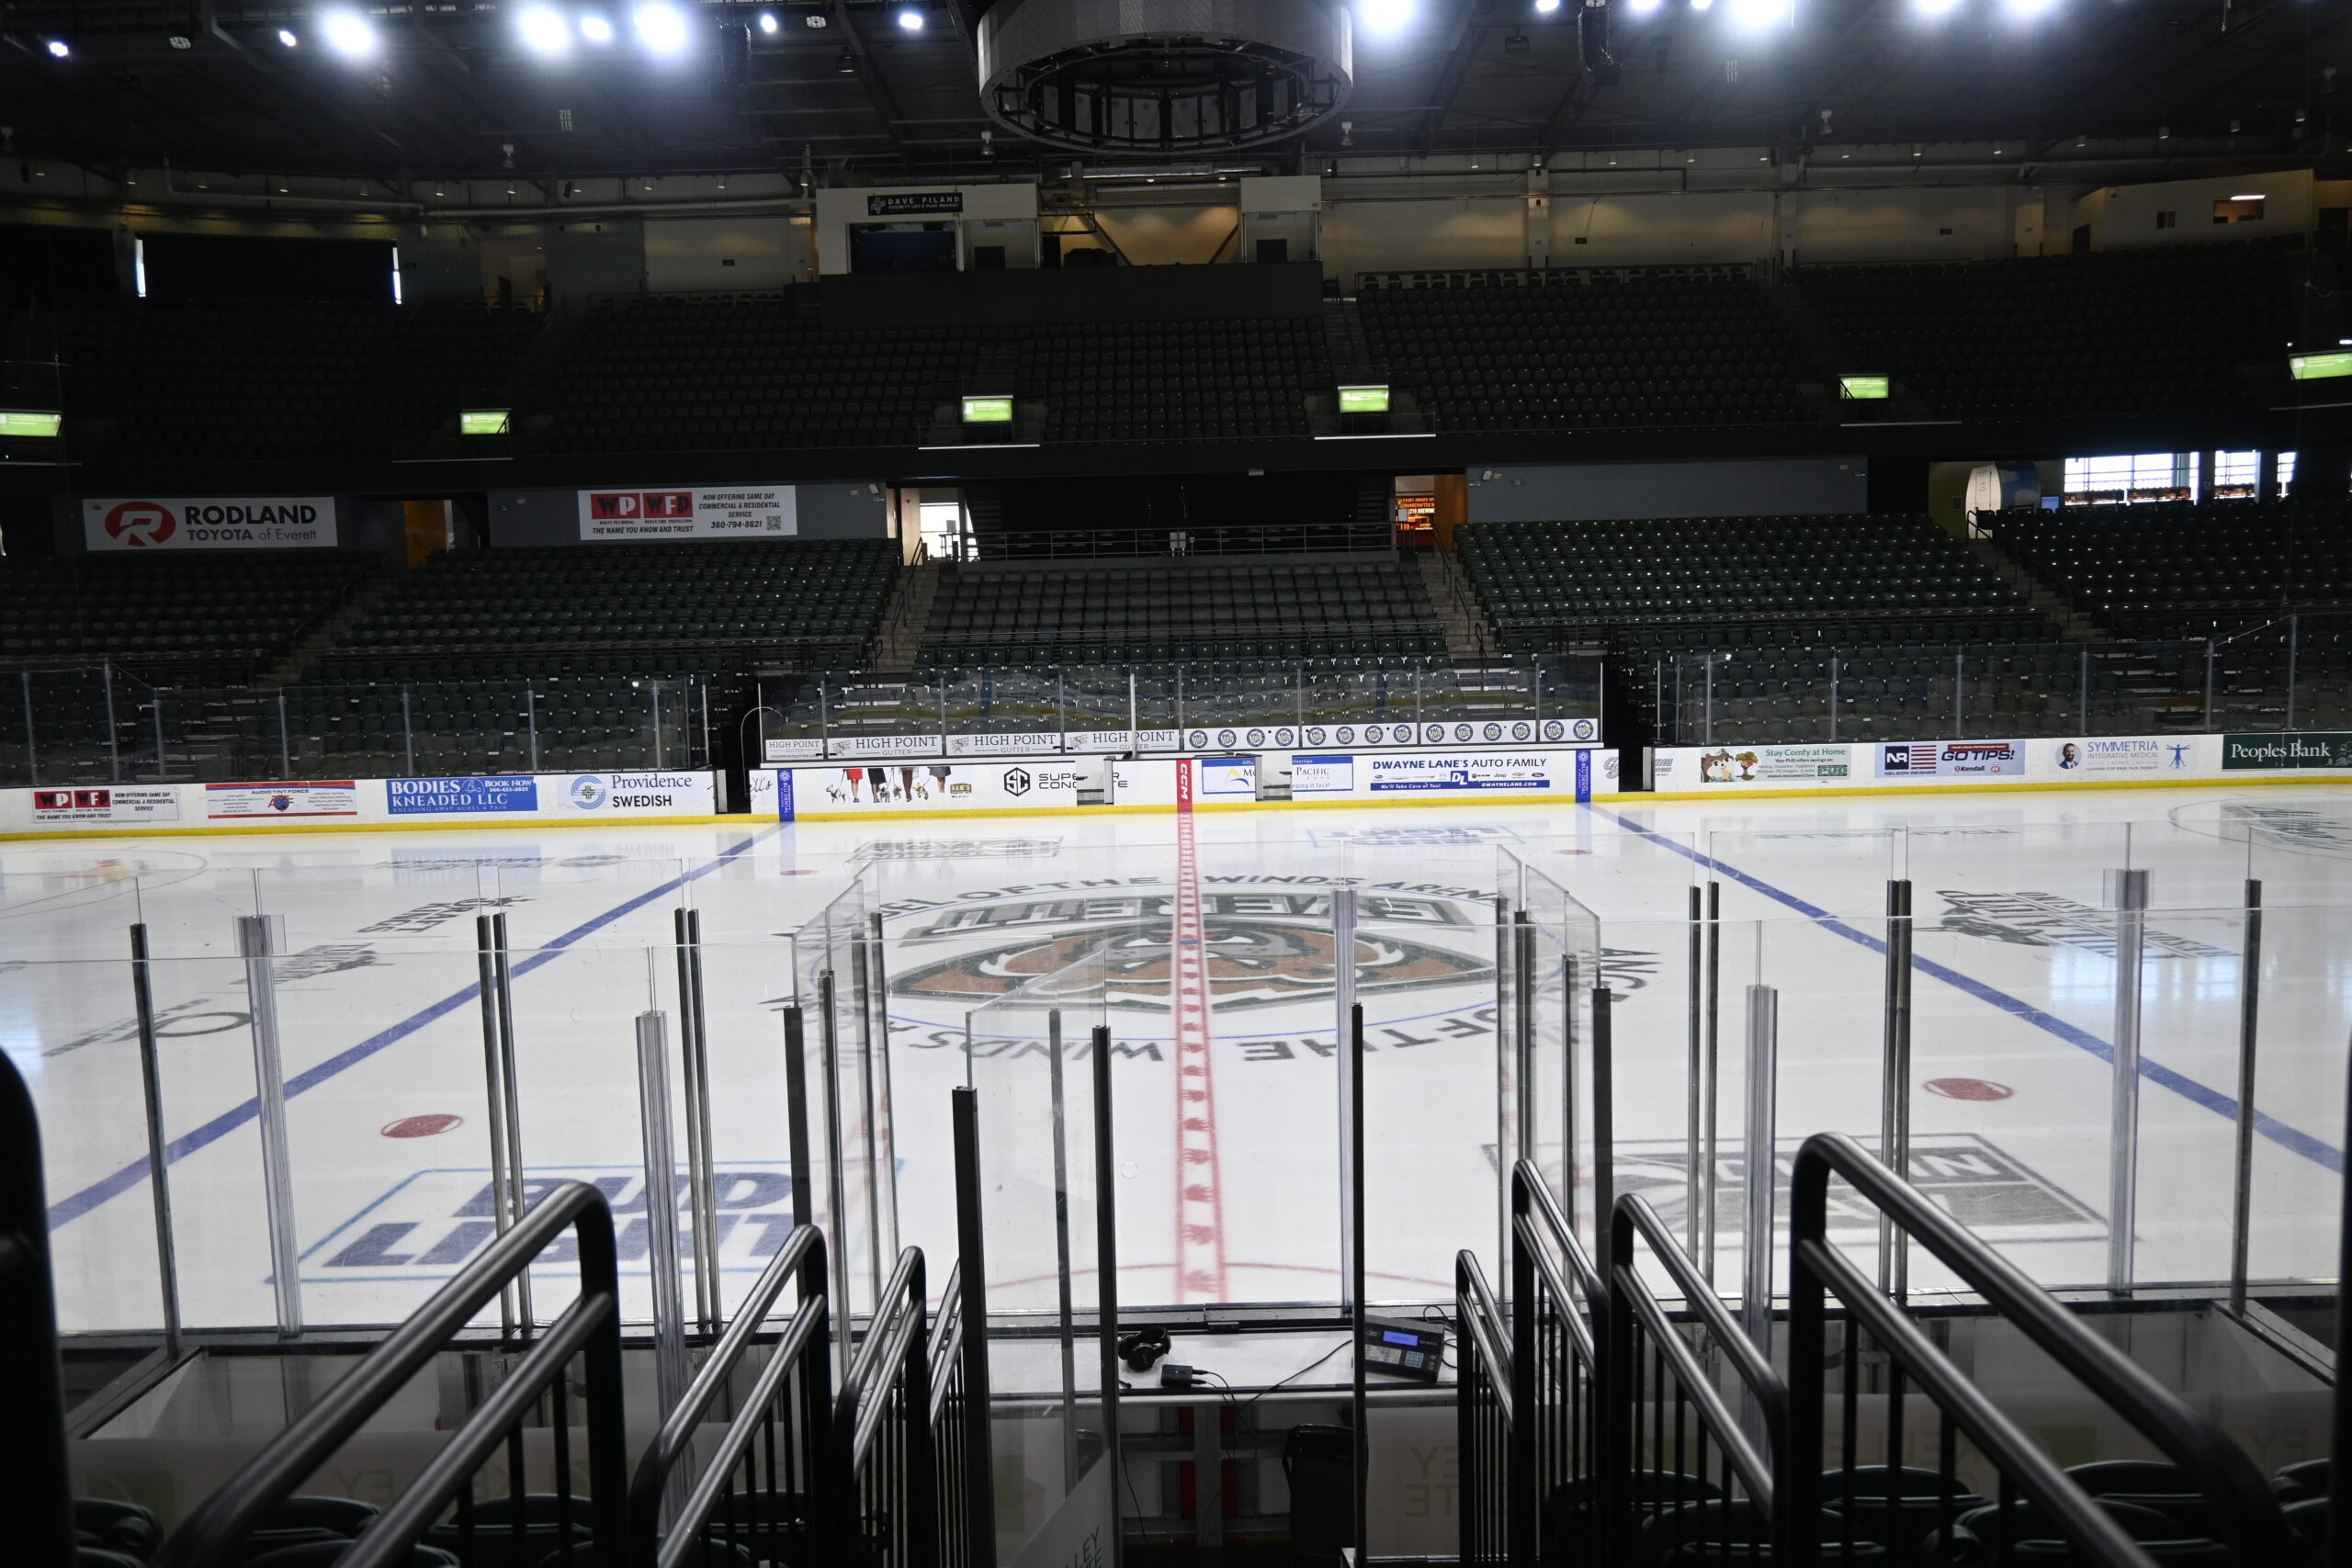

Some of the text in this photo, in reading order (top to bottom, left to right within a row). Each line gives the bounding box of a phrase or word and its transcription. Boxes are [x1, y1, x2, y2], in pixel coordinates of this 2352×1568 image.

[922, 196, 960, 204] PILAND
[184, 505, 317, 525] RODLAND
[710, 521, 763, 529] 360-794-8621
[187, 527, 317, 541] TOYOTA of Everett
[856, 737, 937, 749] HIGH POINT
[975, 734, 1057, 746] HIGH POINT
[1093, 732, 1128, 742] HIGH
[2087, 740, 2158, 751] SYMMETRIA
[2232, 741, 2330, 761] Peoples Bank
[1941, 750, 2015, 761] GO TIPS!
[1373, 758, 1547, 770] DWAYNE LANE'S AUTO FAMILY
[511, 779, 533, 787] NOW
[611, 773, 692, 789] Providence
[1180, 762, 1188, 799] CCM
[390, 780, 459, 795] BODIES
[392, 793, 507, 807] KNEADED LLC
[612, 795, 673, 808] SWEDISH
[1037, 876, 1162, 889] THE
[1204, 874, 1365, 887] WINDS
[1378, 882, 1504, 907] ARENA
[910, 1029, 1163, 1063] WINDS
